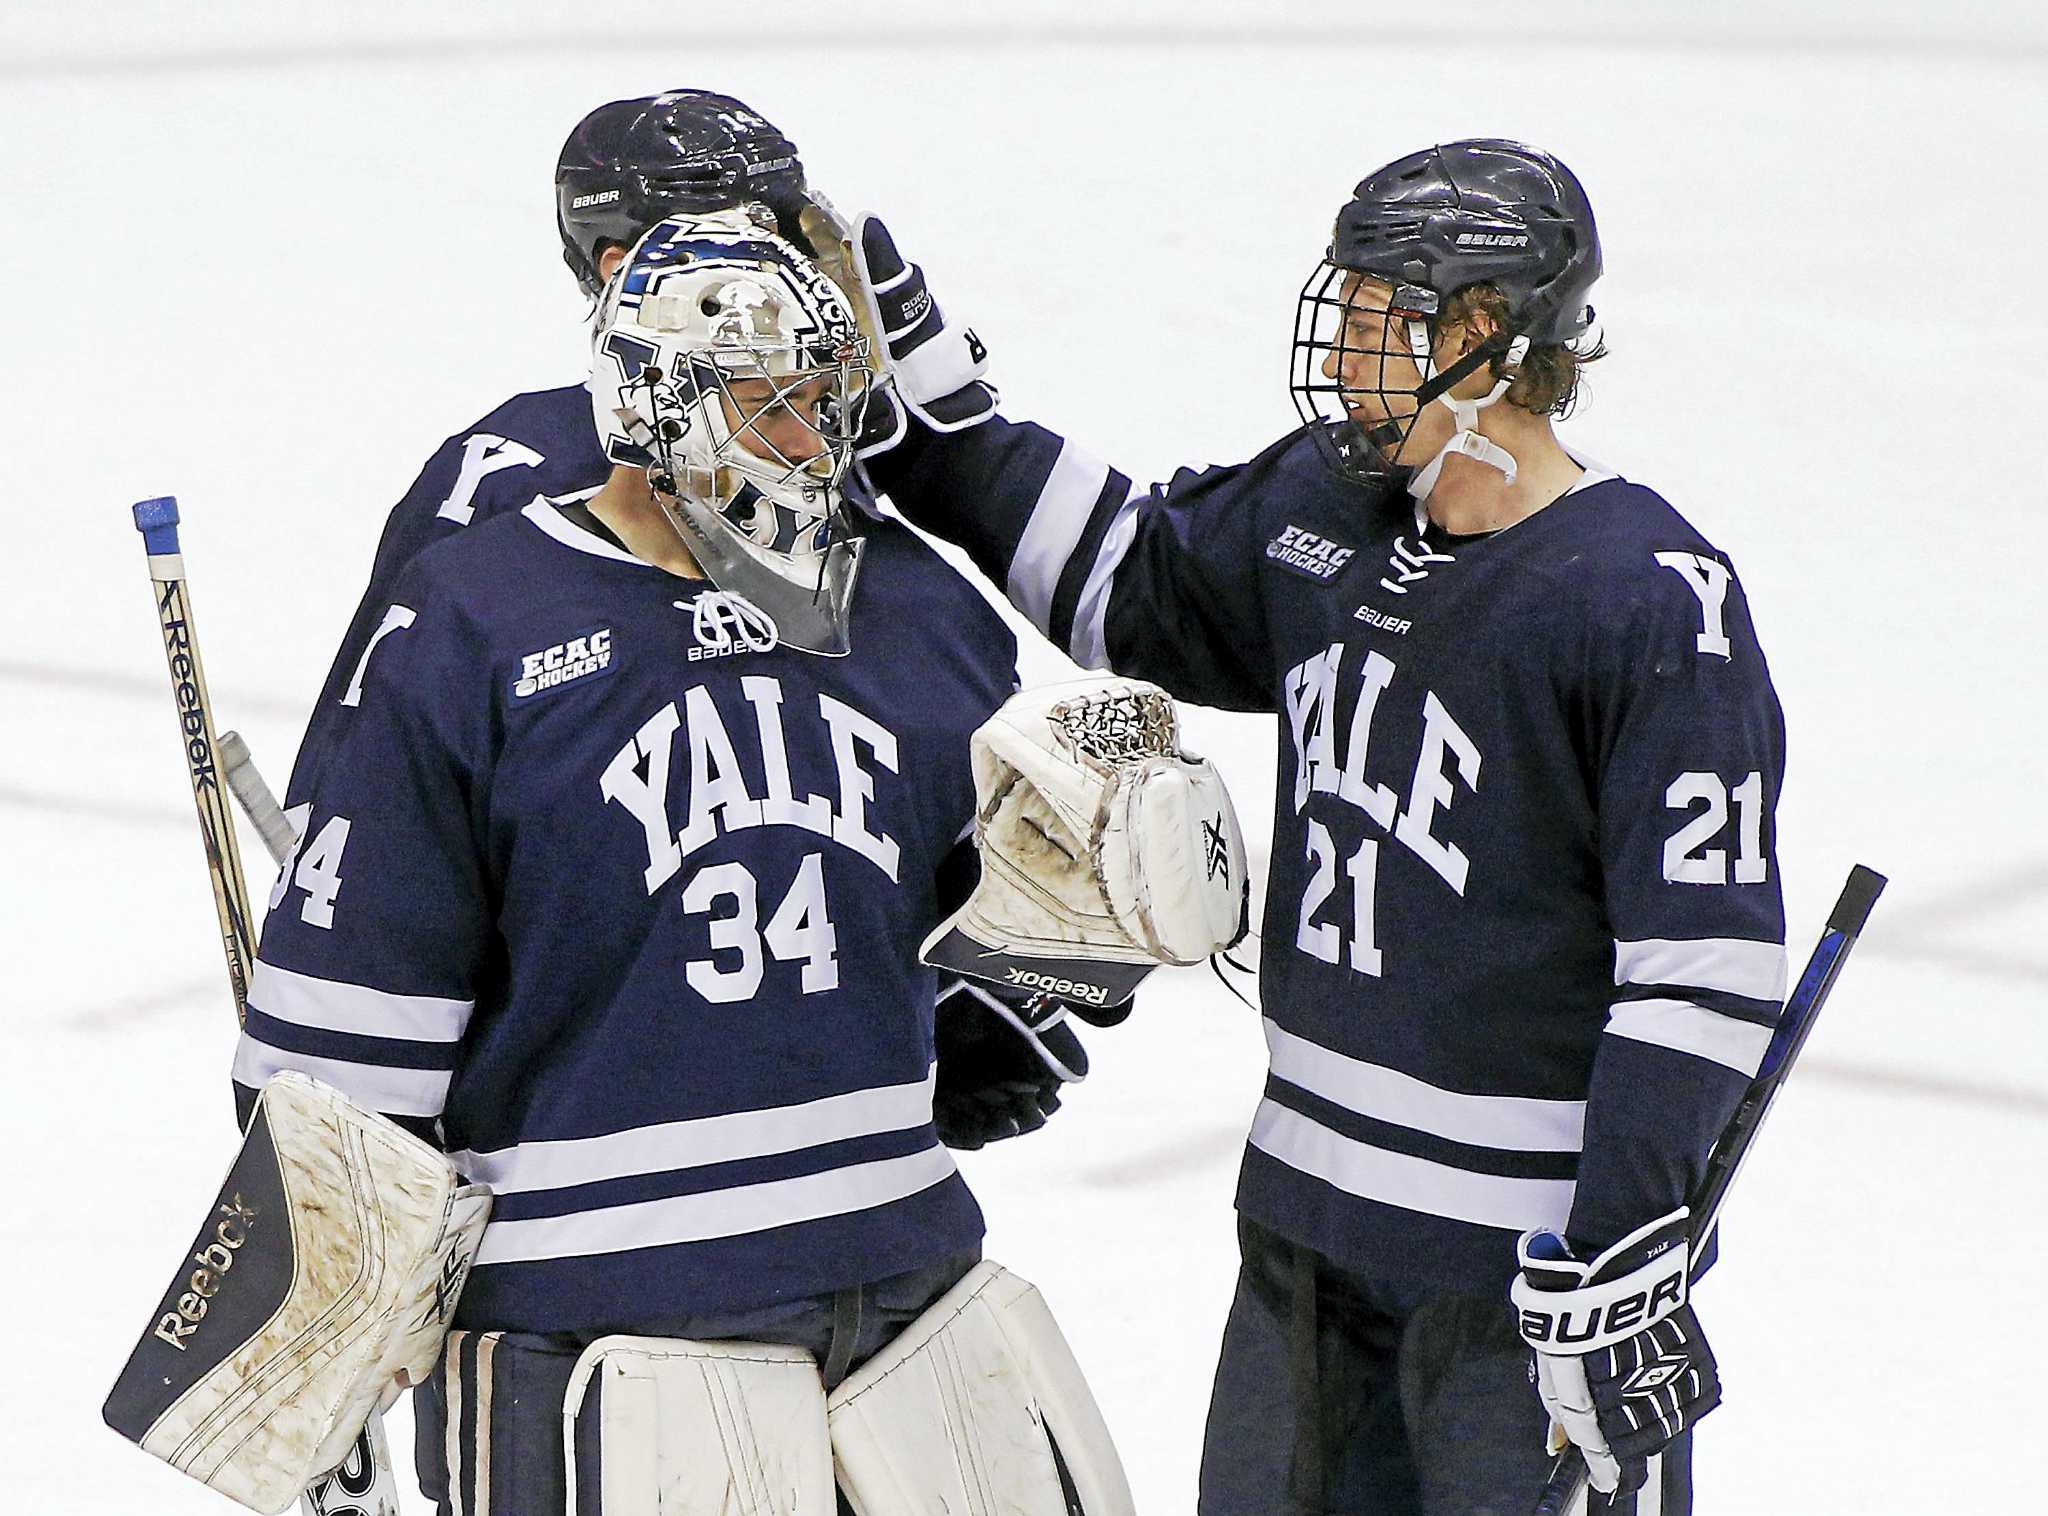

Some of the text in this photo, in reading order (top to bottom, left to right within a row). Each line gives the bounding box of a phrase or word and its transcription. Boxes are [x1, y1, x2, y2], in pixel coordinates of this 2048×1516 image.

[437, 433, 546, 526] Y
[1277, 524, 1355, 567] ECAC
[1277, 546, 1338, 578] HOCKEY
[522, 628, 611, 679] ECAC
[1654, 550, 1732, 663] Y
[165, 618, 216, 793] Reebok
[537, 650, 611, 691] HOCKEY
[600, 675, 900, 896] YALE
[1285, 643, 1482, 897] YALE
[1663, 771, 1767, 885] 21
[681, 852, 840, 1004] 34
[1297, 817, 1383, 978] 21
[1004, 966, 1109, 1005] Reebok
